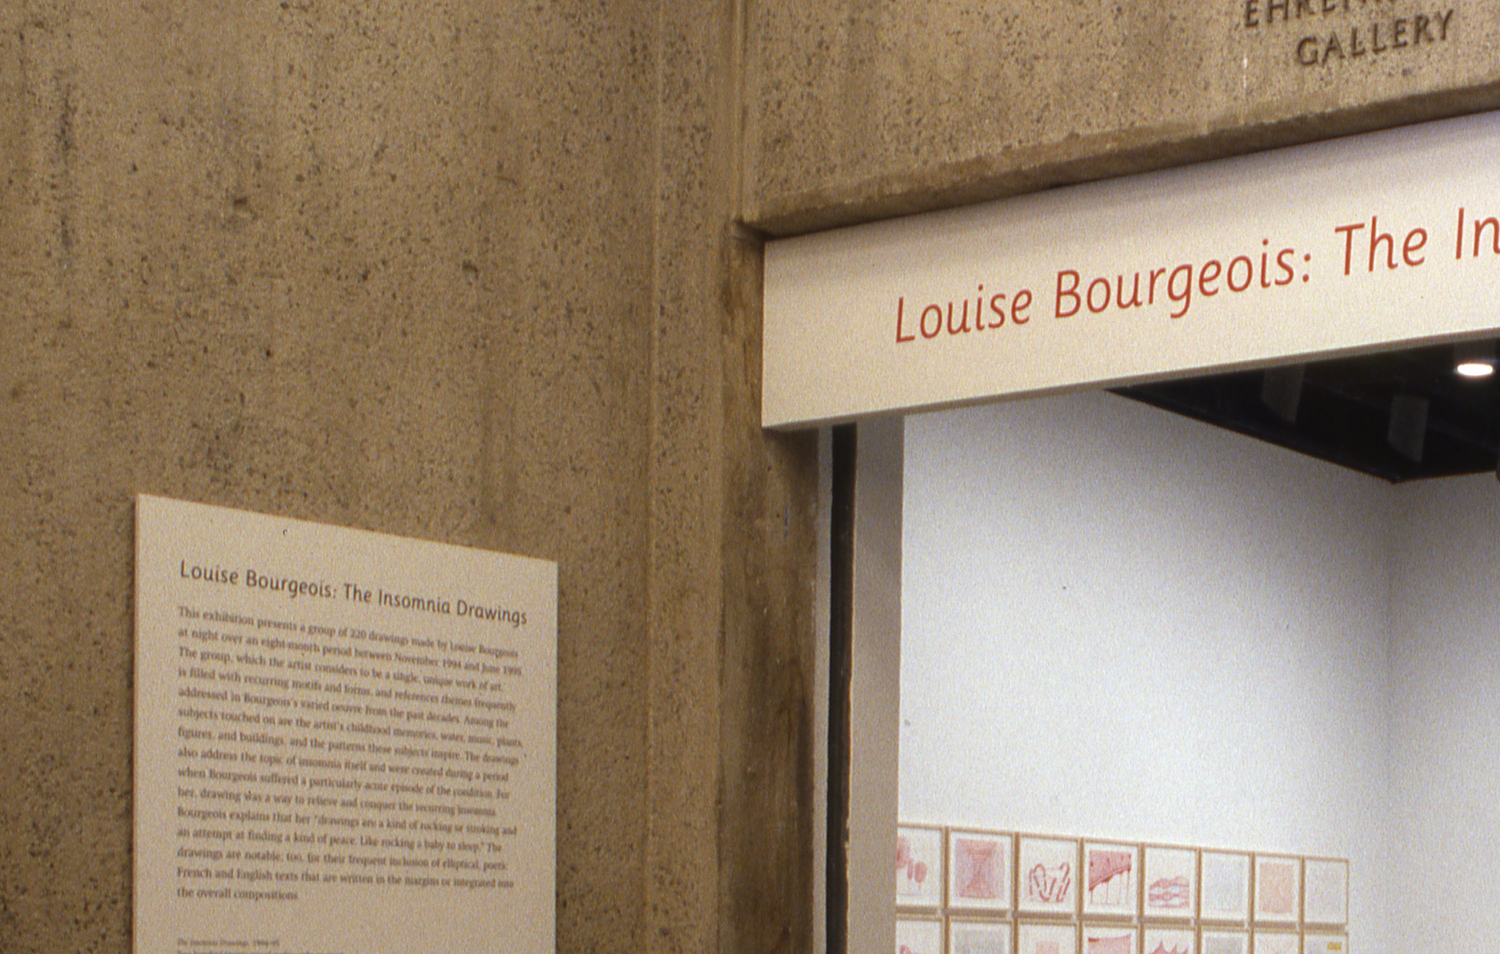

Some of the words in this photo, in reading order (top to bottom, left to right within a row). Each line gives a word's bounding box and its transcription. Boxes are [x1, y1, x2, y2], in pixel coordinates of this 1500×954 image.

[1296, 10, 1453, 66] GALLERY
[897, 285, 1032, 343] Louise
[1055, 239, 1311, 319] Bourgeois:
[1335, 215, 1427, 276] The
[180, 560, 239, 584] Louise
[246, 569, 338, 599] Bourgeois:
[344, 582, 371, 603] The
[379, 589, 450, 614] Insomnia
[457, 599, 528, 628] Drawings
[178, 605, 199, 619] This
[202, 610, 254, 626] exhibition
[257, 618, 297, 631] presents
[307, 624, 335, 638] group
[338, 626, 347, 637] of
[177, 626, 188, 637] at
[191, 628, 218, 643] night
[221, 633, 242, 644] over
[246, 636, 258, 645] an
[322, 645, 352, 656] period
[463, 660, 479, 671] and
[178, 645, 196, 658] The
[236, 653, 266, 666] which
[268, 655, 283, 668] the
[287, 658, 311, 670] artist
[314, 663, 357, 675] considers
[178, 666, 186, 677] is
[189, 666, 215, 680] filled
[218, 671, 241, 682] with
[244, 674, 288, 690] recurring
[292, 679, 321, 691] motifs
[324, 681, 341, 693] and
[375, 687, 392, 698] and
[178, 686, 227, 701] addressed
[230, 691, 240, 702] in
[300, 699, 329, 710] varied
[177, 706, 218, 721] subjects
[220, 709, 260, 723] touched
[262, 715, 275, 725] on
[278, 717, 292, 726] are
[295, 716, 310, 728] the
[346, 721, 390, 735] childhood
[217, 730, 236, 741] and
[289, 735, 307, 747] and
[309, 736, 324, 748] the
[328, 739, 365, 752] patterns
[177, 746, 198, 758] also
[201, 747, 237, 761] address
[240, 750, 256, 762] the
[259, 751, 281, 766] topic
[285, 754, 296, 765] of
[298, 755, 341, 768] insomnia
[344, 758, 366, 770] itself
[369, 761, 385, 771] and
[177, 766, 205, 778] when
[209, 767, 257, 783] Bourgeois
[260, 772, 298, 784] suffered
[309, 775, 361, 791] particularly
[199, 786, 240, 803] drawing
[244, 792, 262, 801] was
[273, 793, 291, 806] way
[294, 792, 304, 804] to
[340, 796, 357, 807] and
[177, 805, 226, 821] Bourgeois
[229, 809, 269, 823] explains
[272, 811, 291, 822] that
[294, 812, 310, 823] her
[502, 824, 517, 834] and
[176, 828, 189, 837] an
[192, 826, 232, 842] attempt
[235, 828, 244, 839] at
[247, 829, 282, 844] finding
[293, 831, 315, 843] kind
[317, 832, 327, 843] of
[176, 845, 222, 861] drawings
[226, 850, 241, 859] are
[307, 851, 319, 862] for
[323, 851, 345, 863] their
[348, 853, 386, 867] frequent
[176, 865, 212, 877] French
[214, 867, 233, 878] and
[236, 867, 272, 882] English
[275, 869, 298, 880] texts
[301, 870, 319, 881] that
[322, 873, 337, 882] are
[339, 872, 373, 883] written
[176, 885, 193, 897] the
[196, 887, 231, 898] overall
